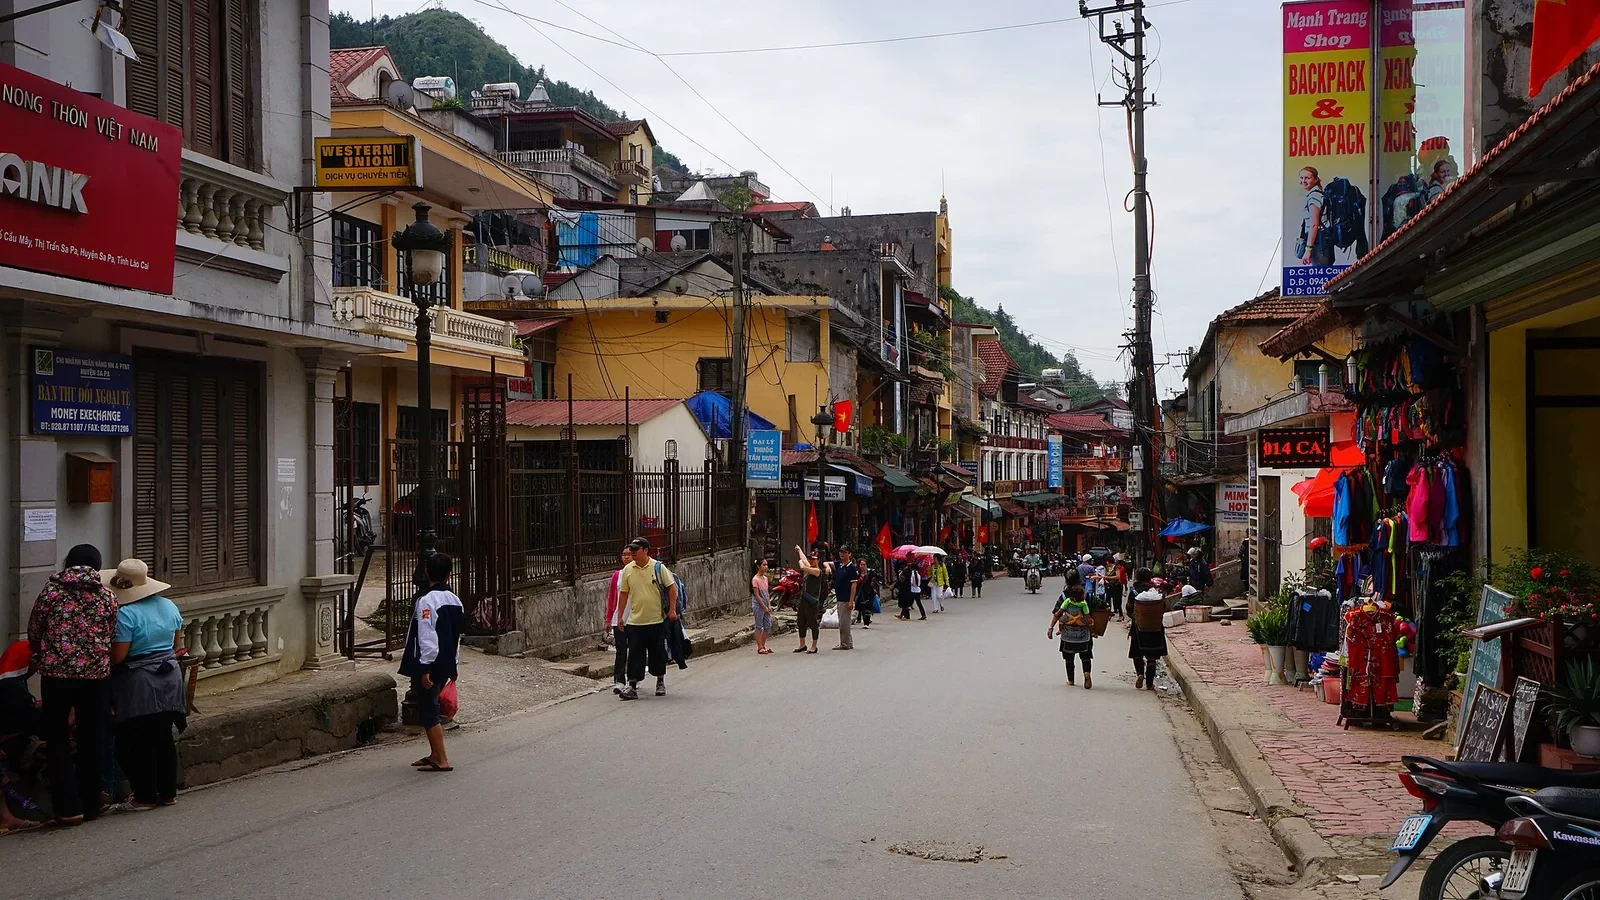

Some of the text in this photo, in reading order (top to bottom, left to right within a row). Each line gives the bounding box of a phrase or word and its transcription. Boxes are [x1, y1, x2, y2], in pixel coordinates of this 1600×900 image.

[1327, 8, 1368, 28] Trang
[1304, 33, 1352, 48] Shop
[1289, 59, 1365, 96] BACKPACK
[1311, 98, 1345, 120] &
[52, 100, 88, 129] THÔN
[97, 116, 124, 141] VIỆT
[131, 128, 158, 152] NAM
[1289, 122, 1365, 158] BACKPACK
[322, 144, 392, 157] WESTERN
[344, 156, 392, 167] UNION
[325, 172, 343, 182] DỊCH
[345, 172, 356, 181] VỤ
[1309, 267, 1323, 275] 014
[51, 407, 121, 422] MONEY EXECHANGE
[1296, 441, 1322, 455] CA
[748, 463, 778, 472] PHARMACY
